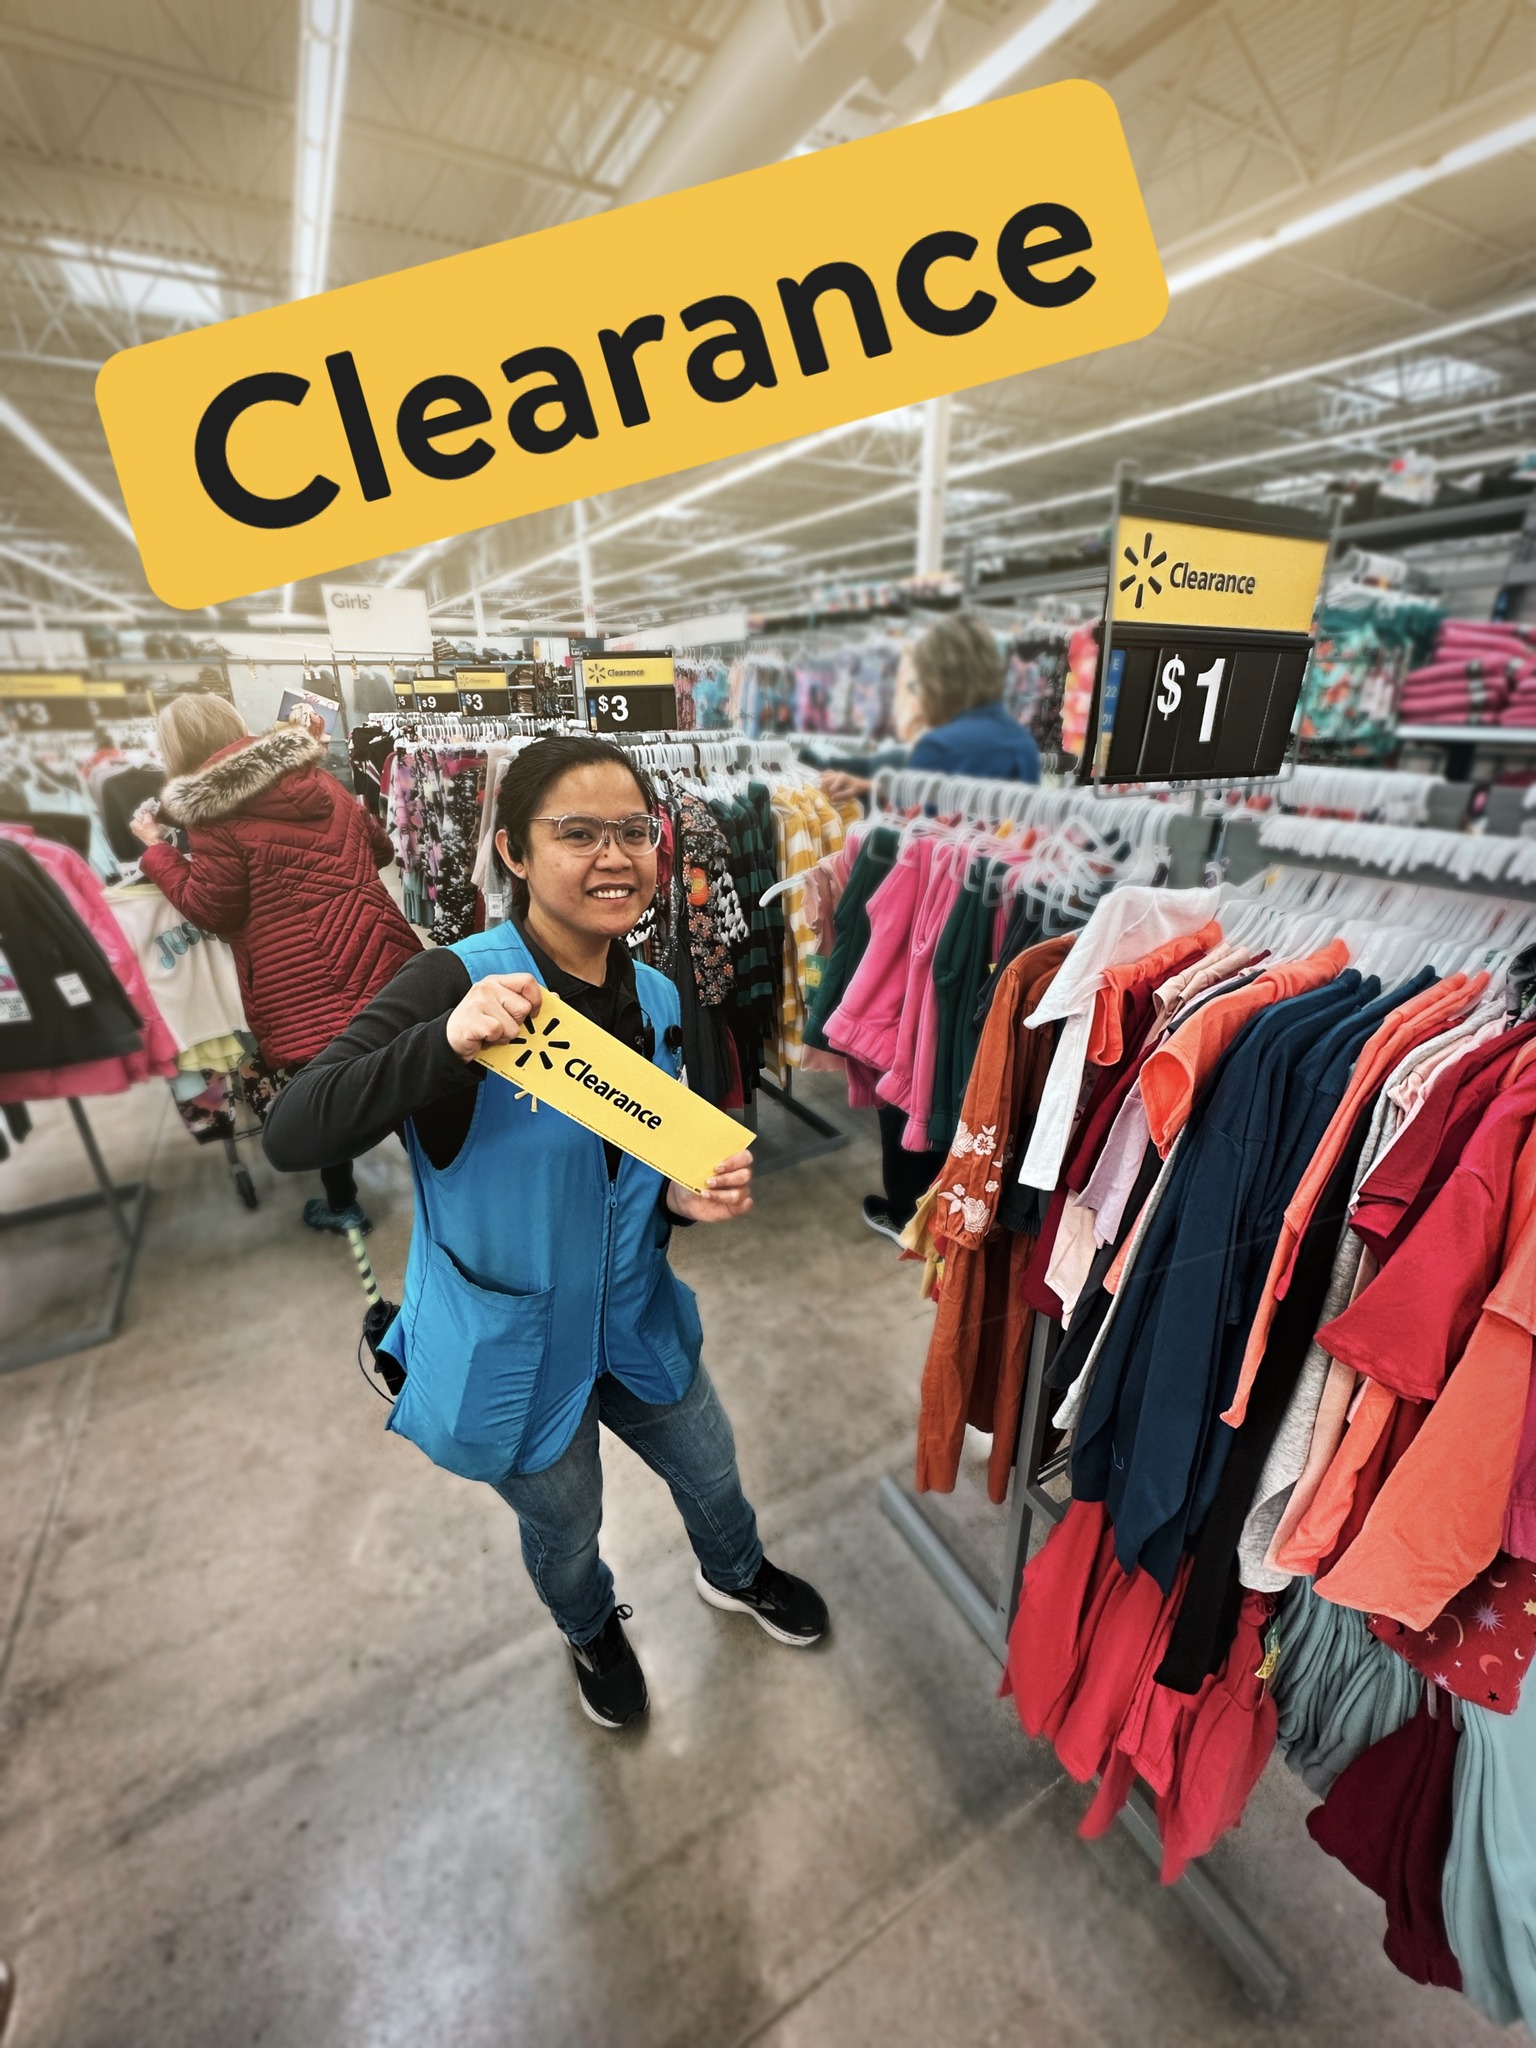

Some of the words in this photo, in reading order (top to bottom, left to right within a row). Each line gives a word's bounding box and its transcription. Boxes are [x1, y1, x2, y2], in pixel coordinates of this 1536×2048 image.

[1169, 562, 1256, 594] Clearance
[607, 669, 645, 677] Clearance
[465, 693, 484, 711] $3
[1105, 686, 1117, 697] 22
[598, 694, 629, 722] $3
[154, 921, 217, 969] JUS
[564, 1057, 662, 1130] Clearance
